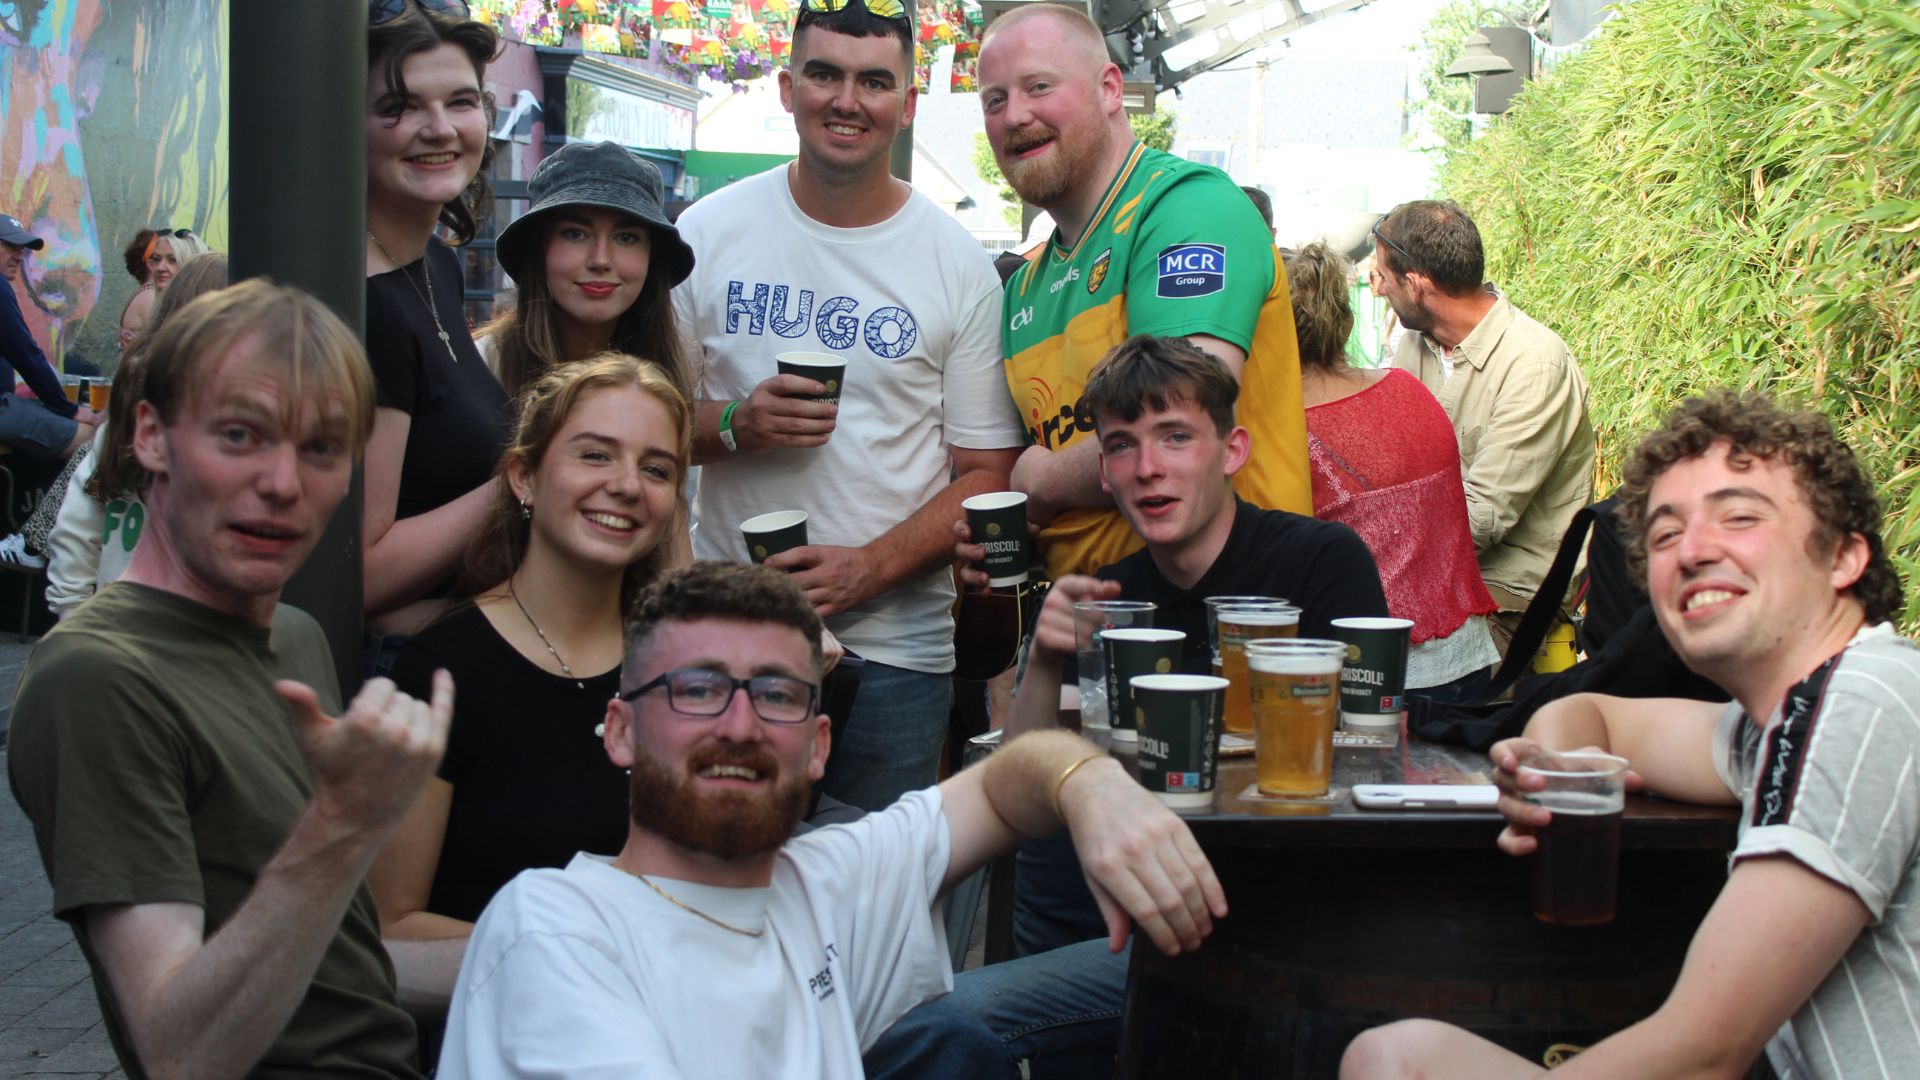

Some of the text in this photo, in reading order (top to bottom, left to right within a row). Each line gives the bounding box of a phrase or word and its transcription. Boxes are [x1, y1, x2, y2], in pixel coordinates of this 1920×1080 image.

[1166, 253, 1216, 272] MCR
[1175, 277, 1205, 286] Group
[725, 281, 917, 359] HUGO
